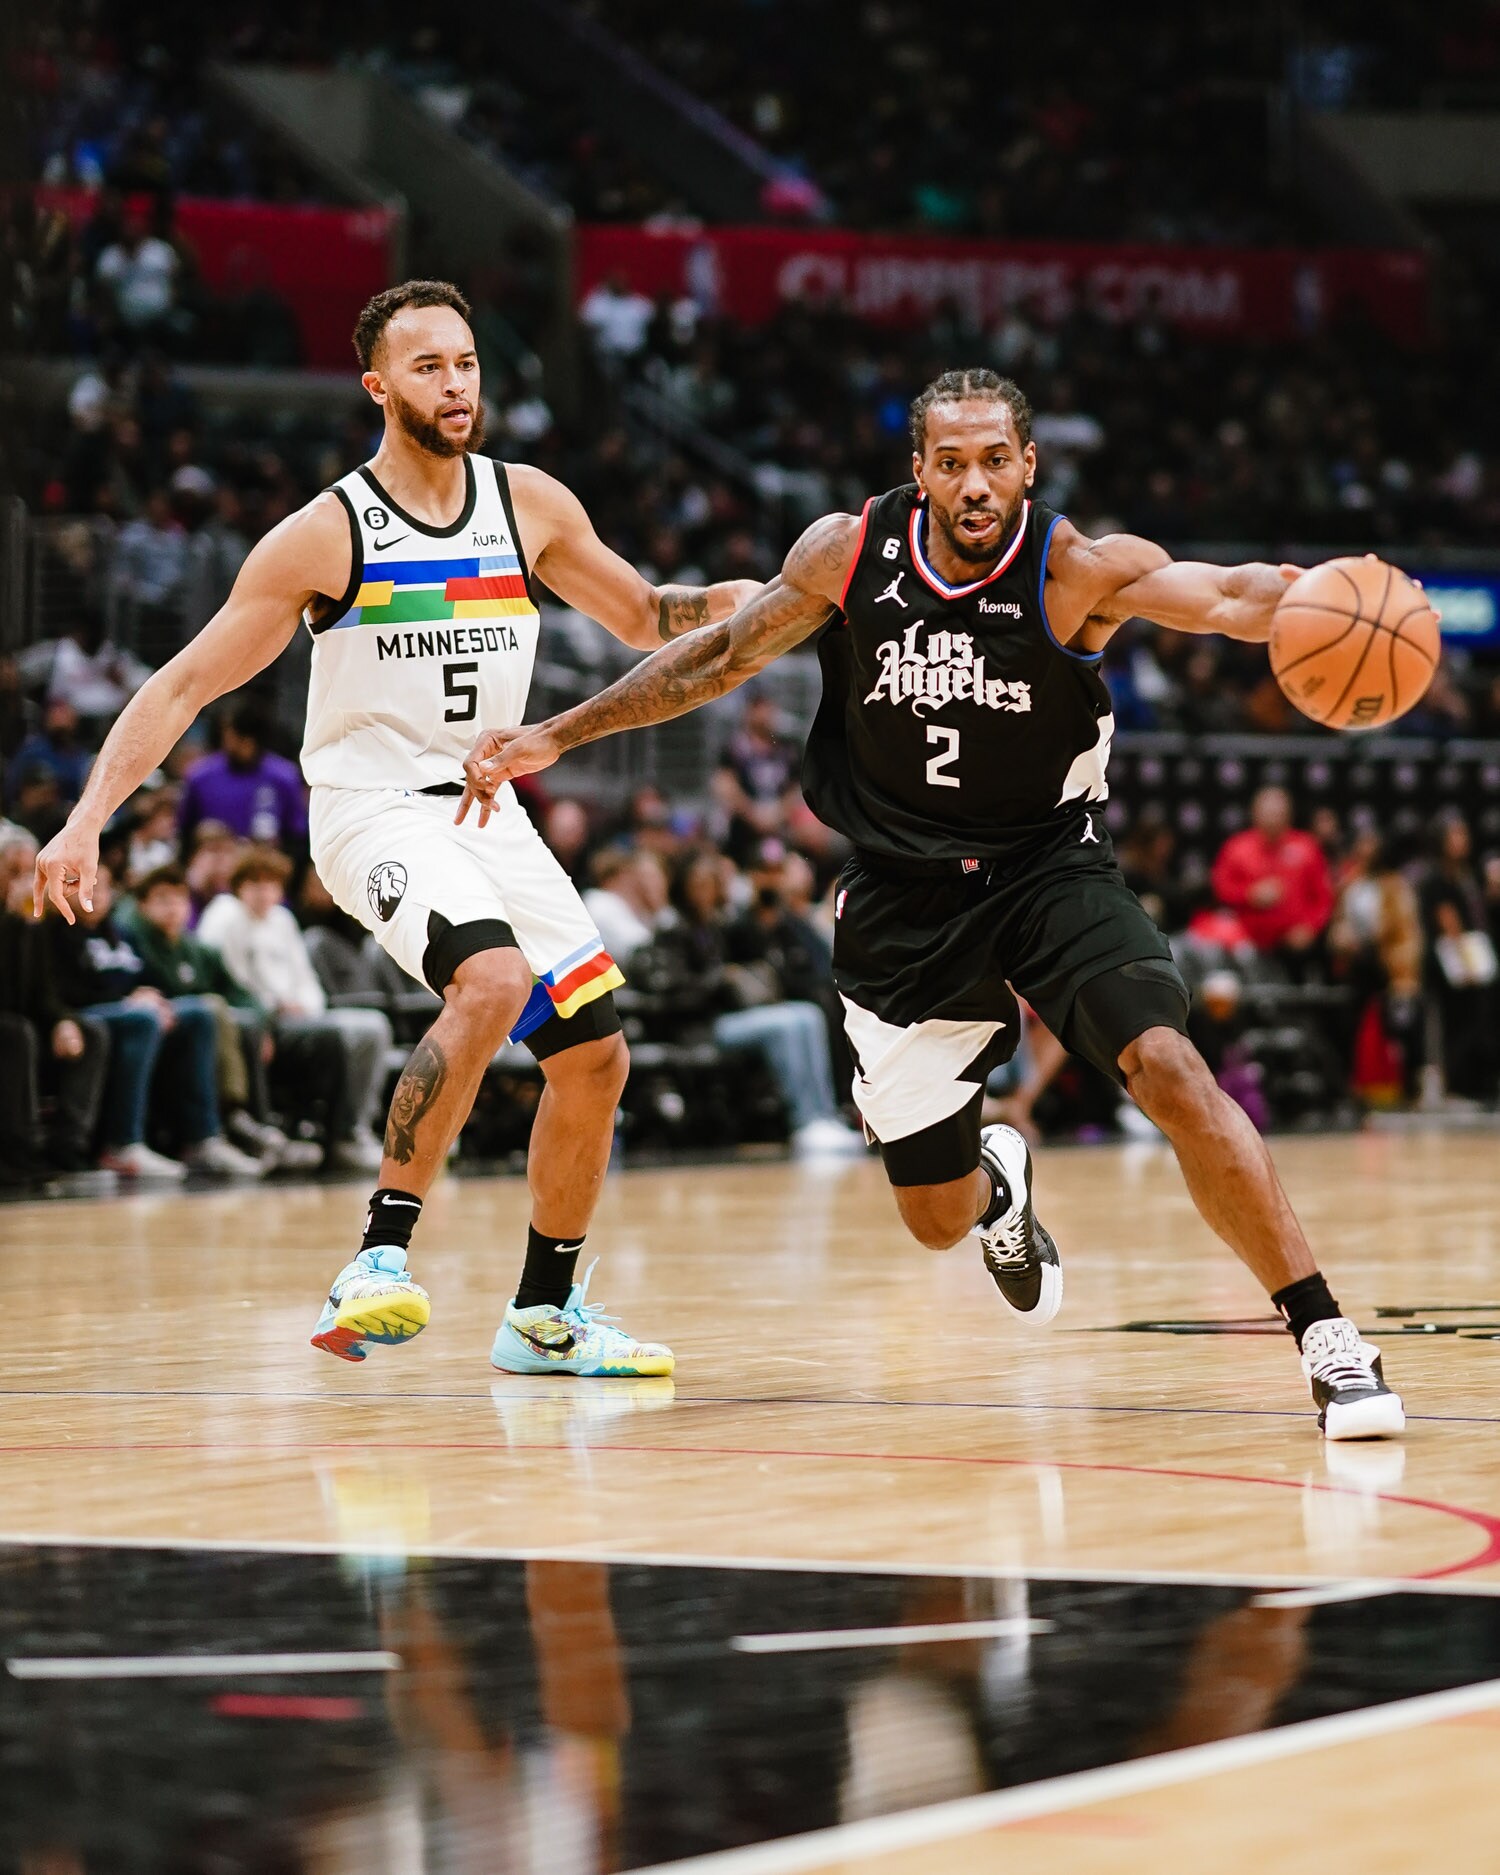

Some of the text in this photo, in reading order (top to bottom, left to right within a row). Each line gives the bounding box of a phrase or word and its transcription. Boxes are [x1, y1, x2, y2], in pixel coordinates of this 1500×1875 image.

[366, 508, 386, 529] 6
[882, 538, 900, 560] 6
[978, 597, 1023, 620] honey
[376, 626, 519, 661] MINNESOTA
[899, 620, 974, 667] Los
[443, 662, 479, 723] 5
[863, 640, 1032, 718] Angeles
[926, 725, 960, 788] 2
